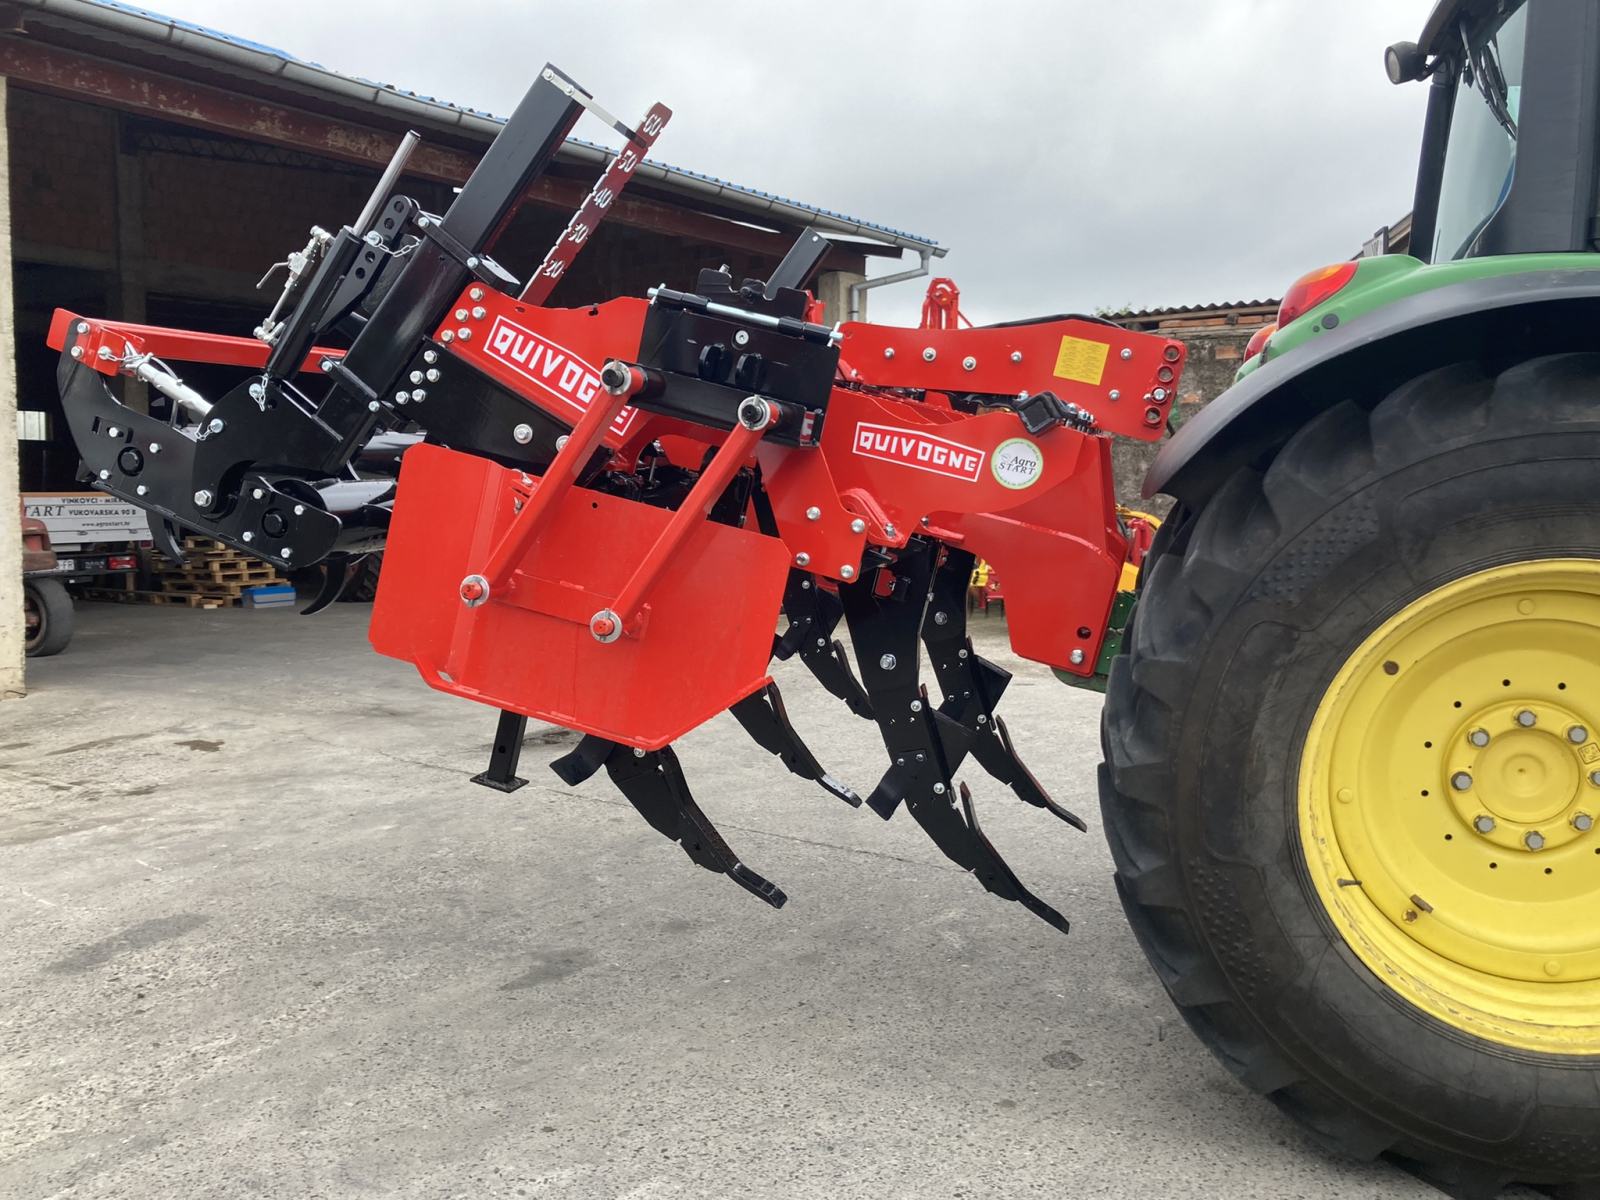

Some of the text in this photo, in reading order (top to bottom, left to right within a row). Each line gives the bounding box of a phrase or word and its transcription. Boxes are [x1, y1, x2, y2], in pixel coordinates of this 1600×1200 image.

[643, 114, 662, 136] 60
[617, 150, 637, 172] 50
[593, 188, 612, 208] 40
[568, 223, 589, 243] 30
[543, 260, 564, 278] 20
[859, 431, 978, 472] QUIVOGNE
[1010, 455, 1037, 467] Agro
[998, 462, 1036, 475] START
[23, 505, 65, 517] TART
